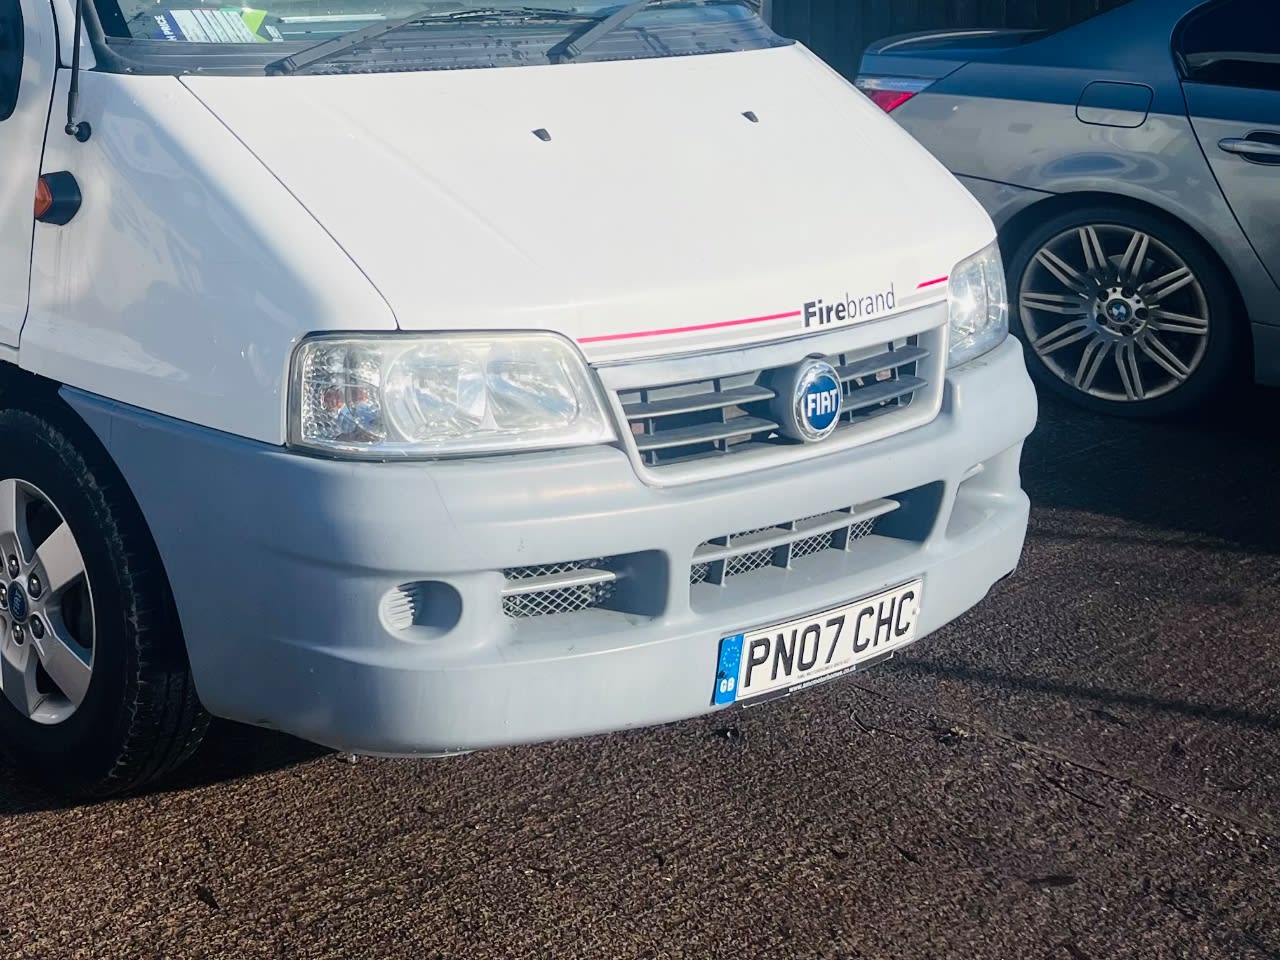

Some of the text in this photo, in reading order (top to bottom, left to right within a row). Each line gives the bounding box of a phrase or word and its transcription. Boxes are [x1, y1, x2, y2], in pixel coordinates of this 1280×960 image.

[803, 282, 896, 328] Firebrand
[807, 388, 838, 417] FIAT
[743, 615, 846, 688] PN07
[851, 590, 916, 654] CHC
[719, 676, 736, 693] GB
